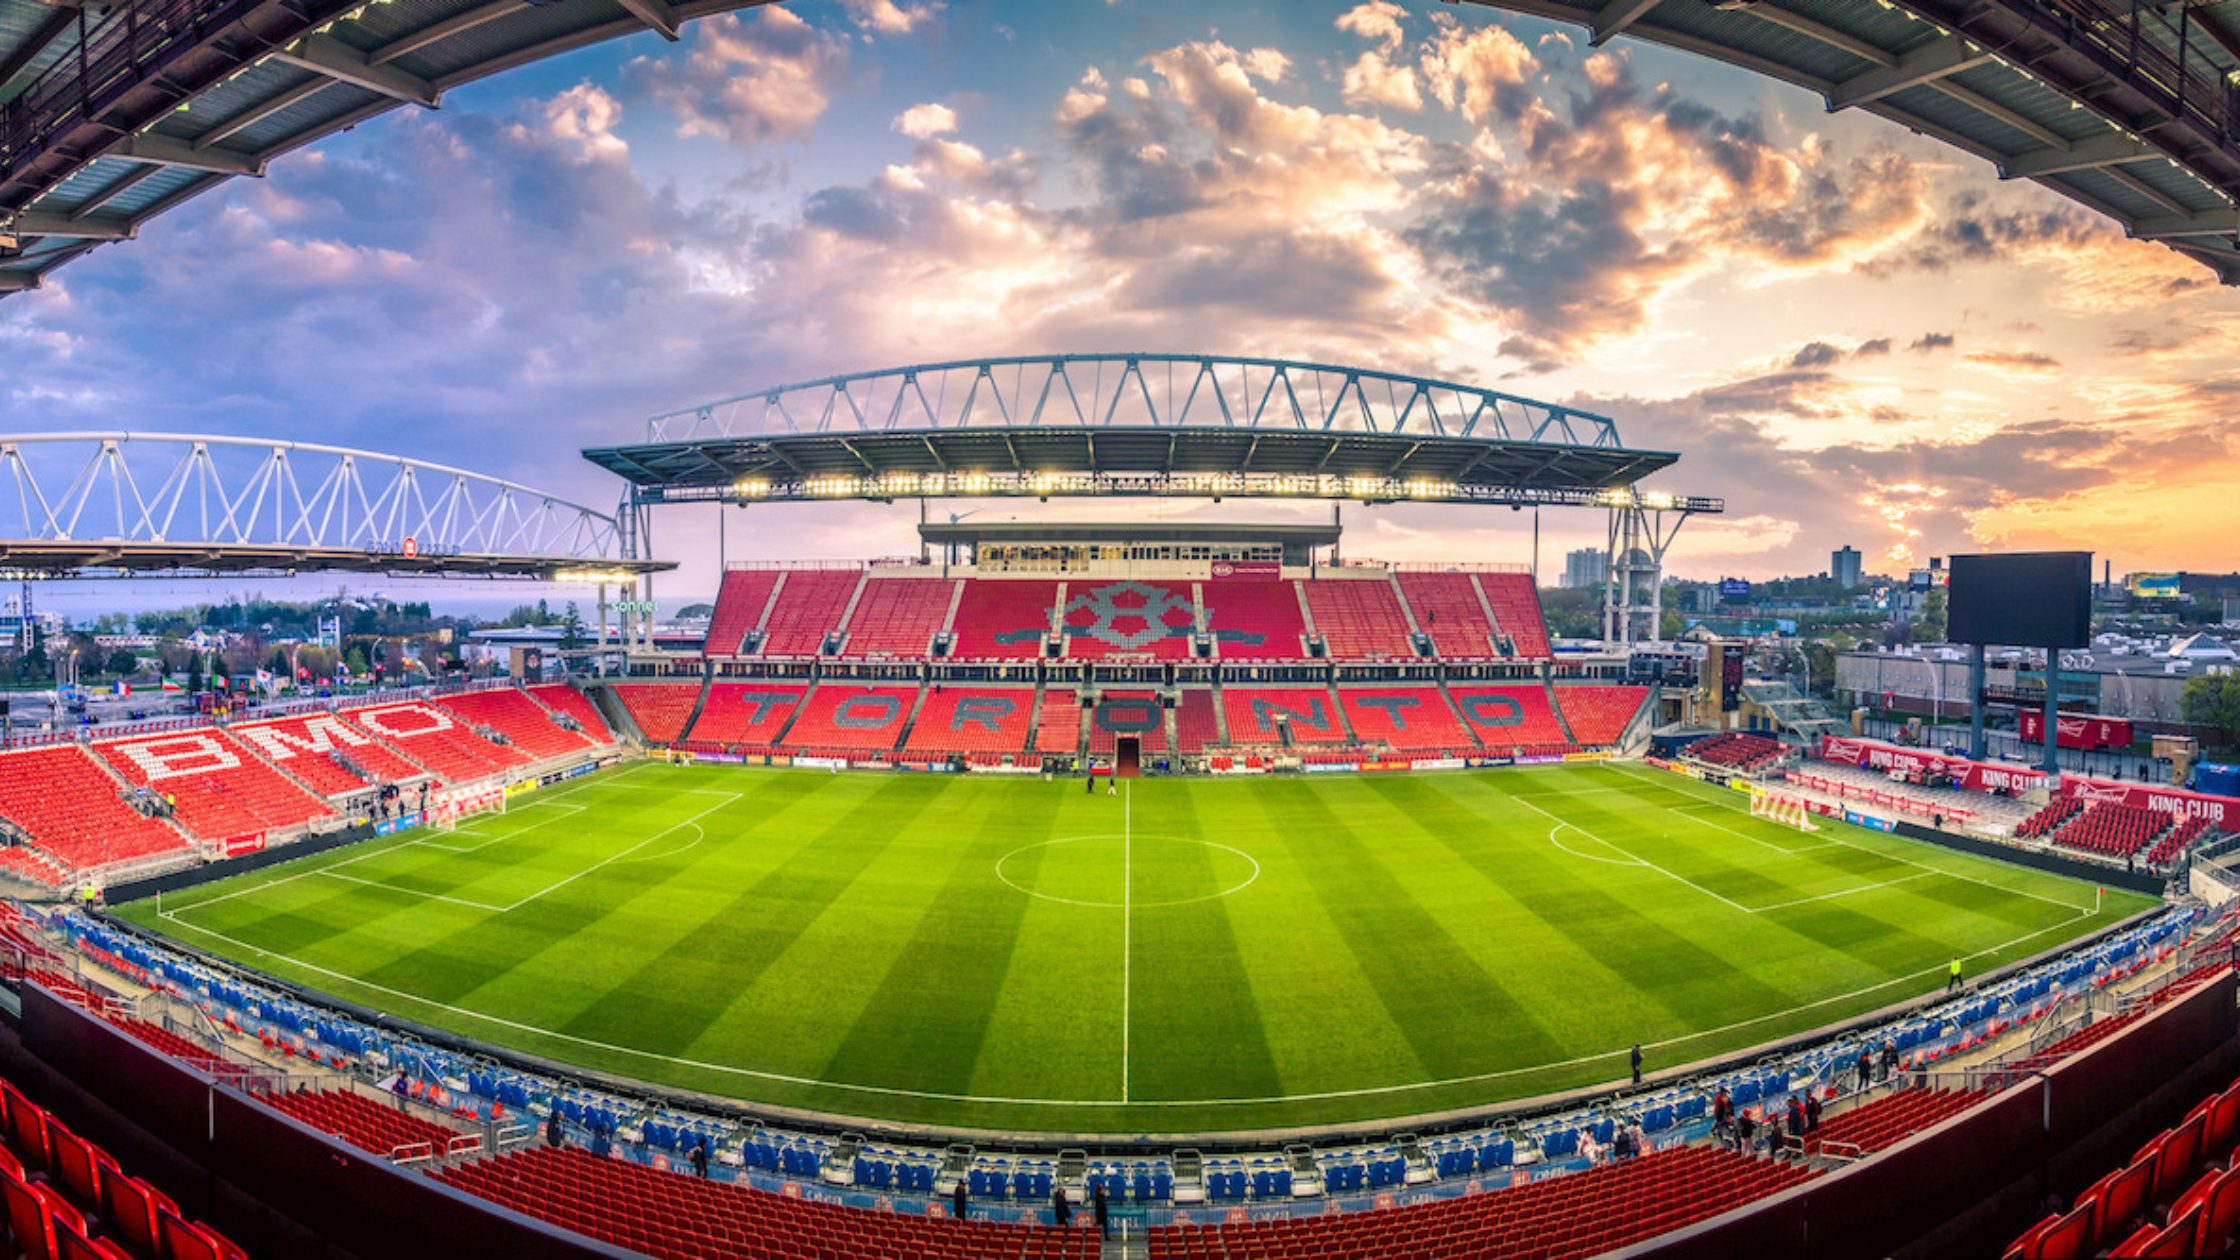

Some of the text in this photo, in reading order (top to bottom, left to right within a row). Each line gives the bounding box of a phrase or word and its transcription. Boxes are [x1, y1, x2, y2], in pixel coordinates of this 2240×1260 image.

[611, 601, 658, 612] sonnet
[113, 704, 453, 780] BMO
[1981, 769, 2010, 788] KING
[2149, 794, 2224, 821] KING CLUB
